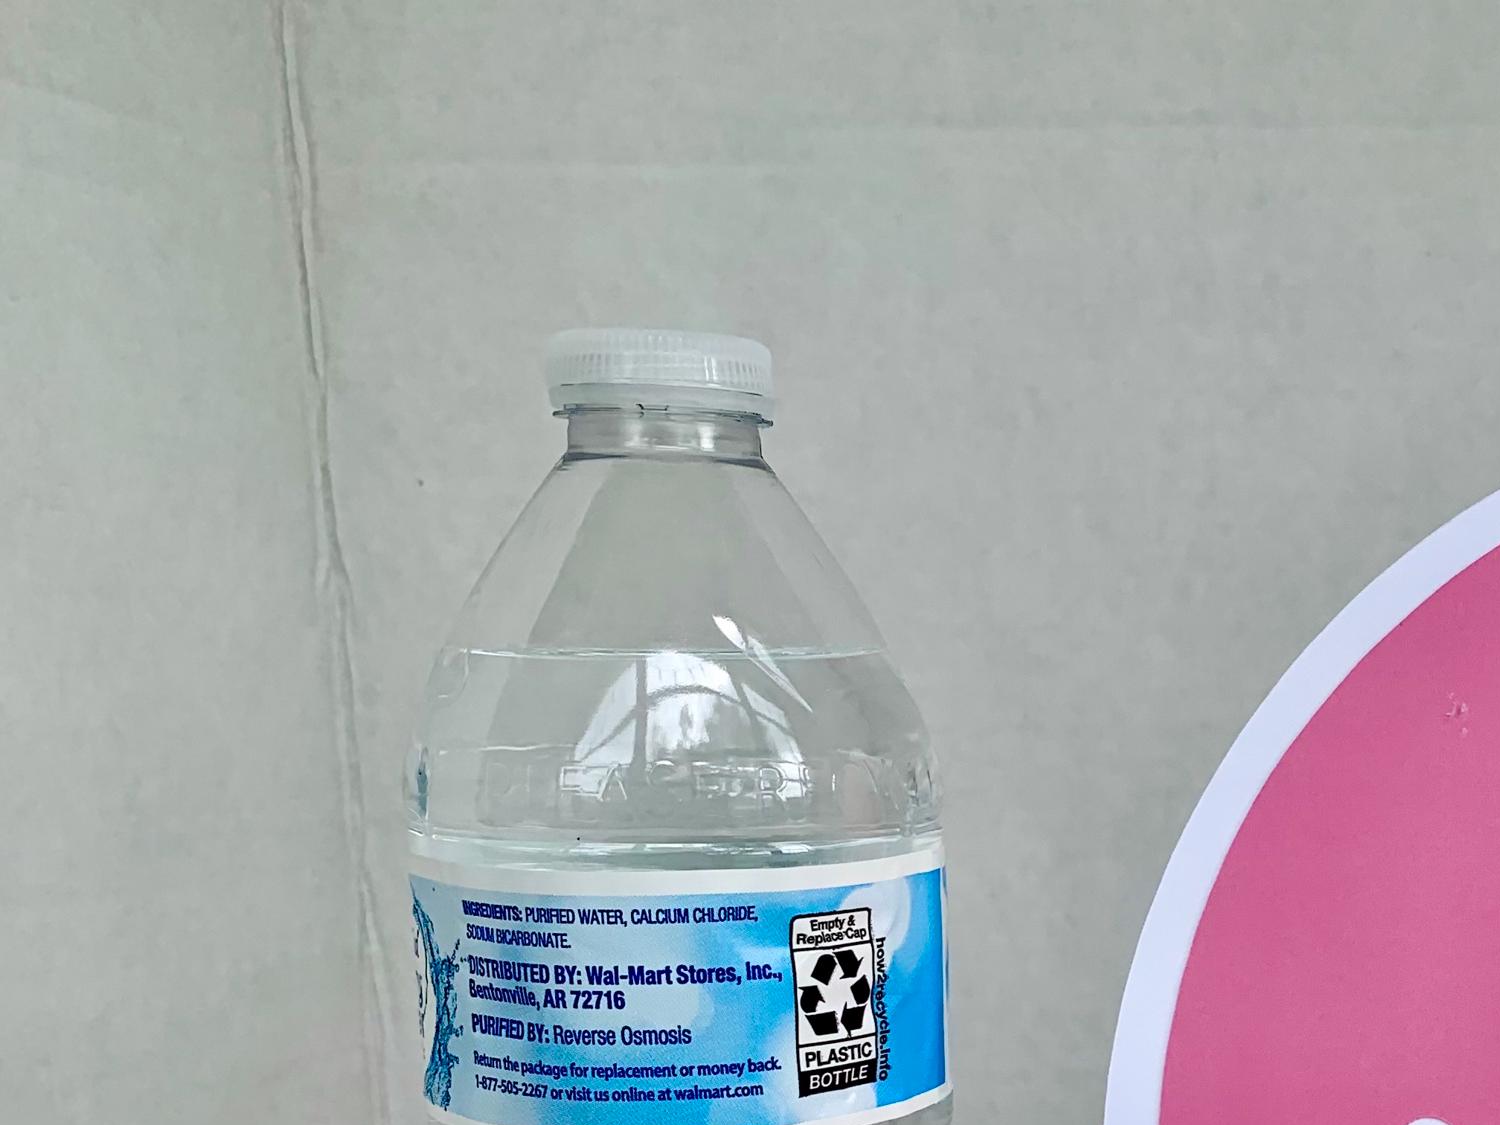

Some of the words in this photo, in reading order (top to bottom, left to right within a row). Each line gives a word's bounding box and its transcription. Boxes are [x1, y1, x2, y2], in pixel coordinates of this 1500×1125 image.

[462, 900, 522, 922] INGREDIENTS:
[525, 907, 575, 924] PURIFIED
[578, 909, 627, 927] WATER,
[631, 908, 689, 924] CALCIUM
[693, 905, 758, 924] CHLORIDE,
[810, 916, 846, 932] Empty
[847, 915, 856, 926] &
[466, 923, 495, 943] SODIUM
[496, 928, 571, 949] BICARBONATE.
[796, 930, 844, 946] Replace
[845, 927, 867, 942] Cap
[468, 955, 550, 984] DISTRIBUTED
[554, 965, 582, 985] BY:
[585, 965, 673, 986] Wal-Mart
[676, 964, 742, 985] Stores,
[745, 961, 783, 982] Inc.,
[469, 978, 541, 1011] Bentonville,
[543, 989, 567, 1009] AR
[570, 990, 626, 1010] 72716
[875, 937, 893, 1082] how2recycle.info
[471, 1013, 524, 1040] PURIFIED
[527, 1022, 550, 1044] BY:
[553, 1025, 616, 1046] Reverse
[621, 1025, 692, 1046] Osmosis
[473, 1050, 502, 1068] Return
[503, 1055, 520, 1072] the
[521, 1060, 568, 1080] package
[569, 1062, 589, 1078] for
[591, 1063, 677, 1081] replacement
[679, 1065, 695, 1077] or
[697, 1062, 745, 1078] money
[747, 1056, 782, 1073] back.
[805, 1042, 872, 1069] PLASTIC
[475, 1074, 548, 1099] 1-877-505-2267
[550, 1088, 563, 1100] or
[565, 1086, 592, 1101] visit
[594, 1089, 609, 1102] us
[611, 1087, 655, 1102] online
[657, 1088, 672, 1101] at
[674, 1084, 764, 1100] walmart.com
[809, 1065, 869, 1090] BOTTLE
